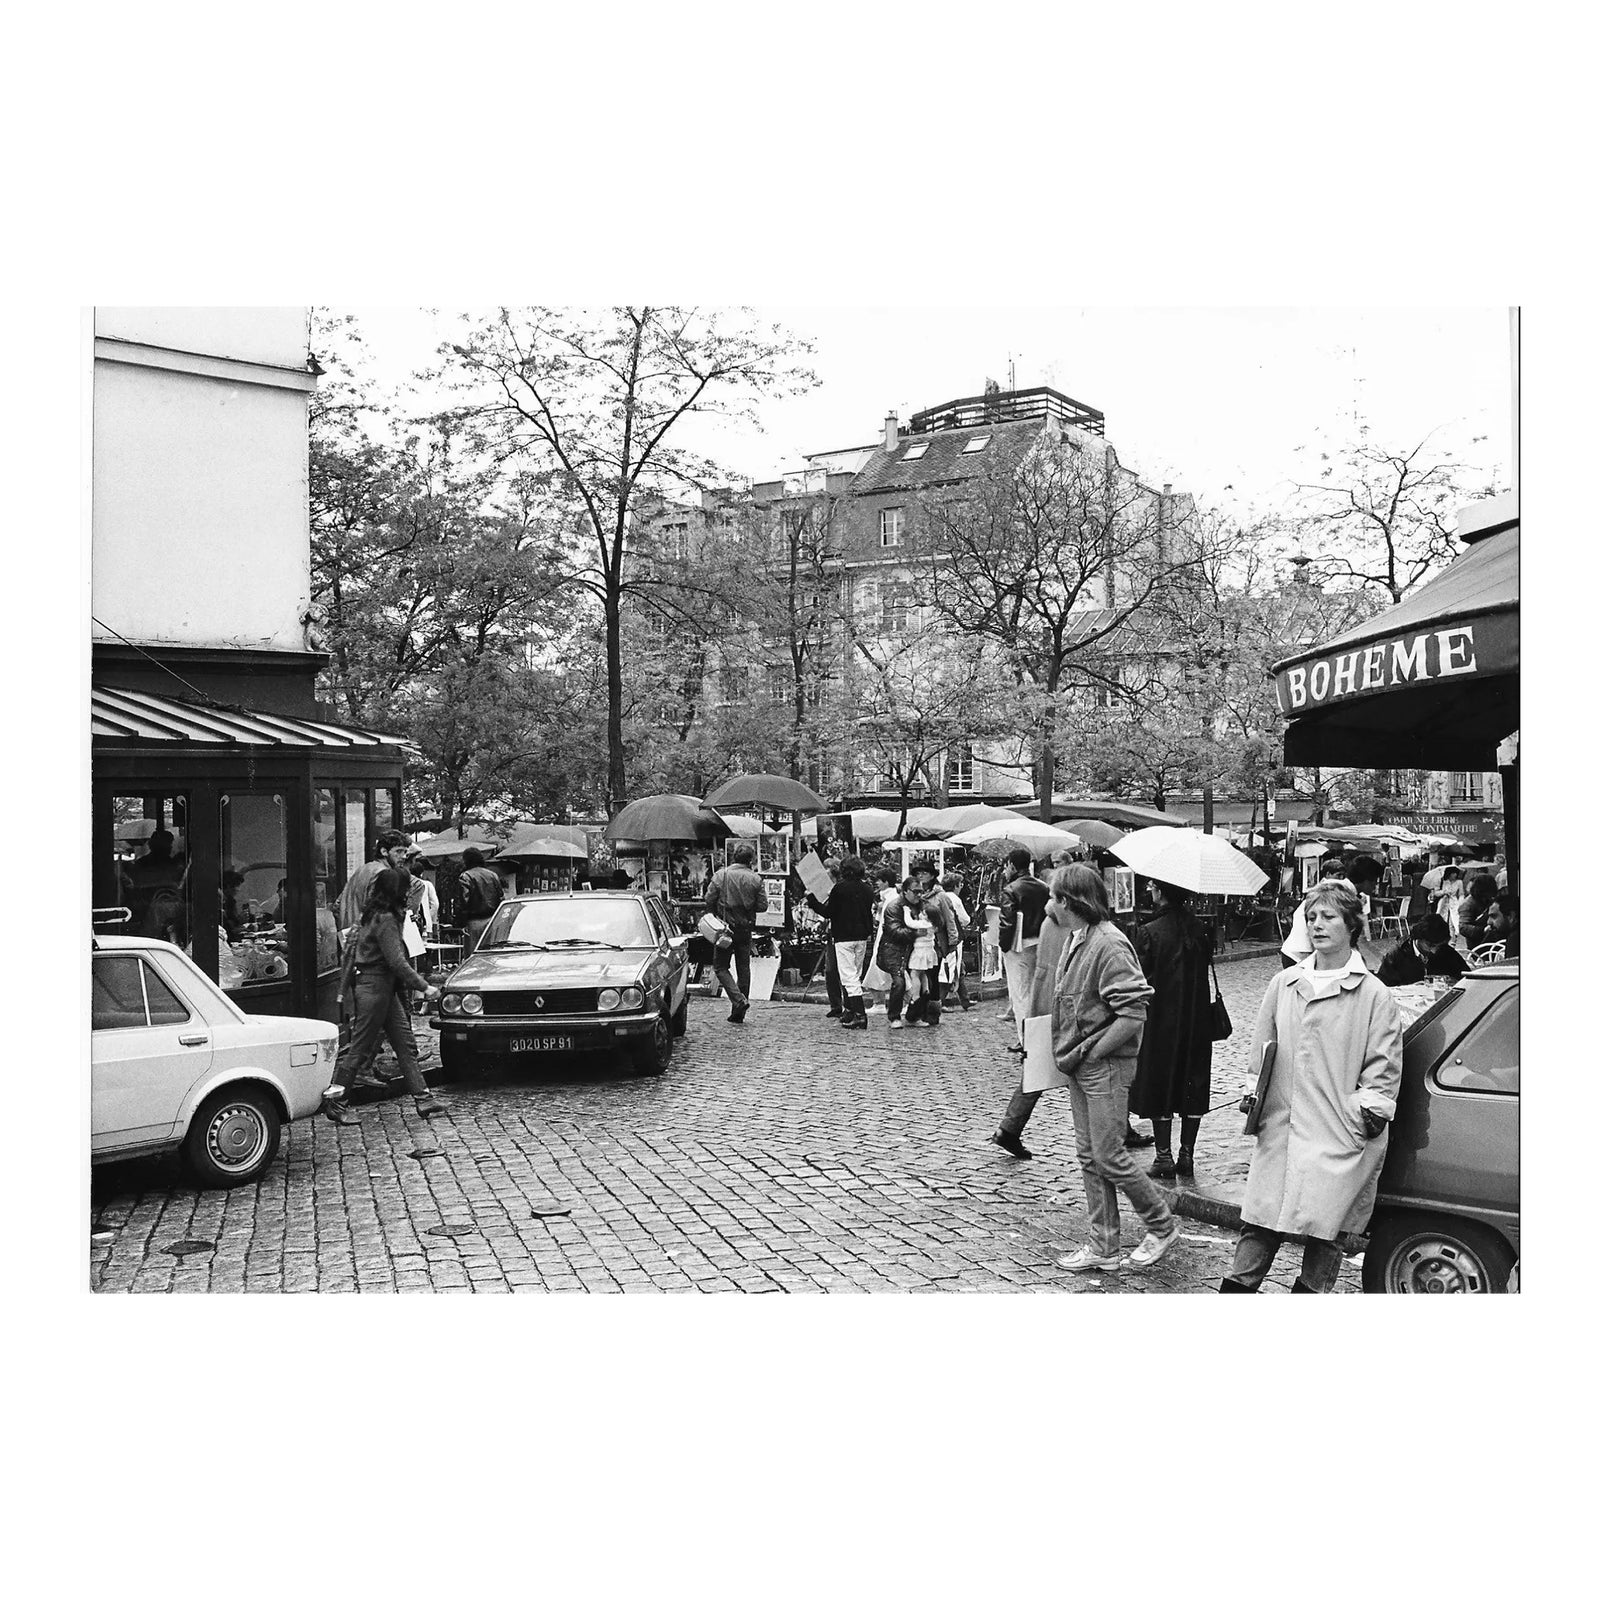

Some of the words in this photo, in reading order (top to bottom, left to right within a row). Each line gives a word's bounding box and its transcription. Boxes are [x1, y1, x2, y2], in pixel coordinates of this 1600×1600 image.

[1288, 626, 1477, 708] BOHEME
[1388, 816, 1428, 824] OMMUNE
[1431, 816, 1459, 824] LIBRE
[1413, 824, 1478, 833] MONTMARTRE
[512, 1038, 540, 1051] 3020
[543, 1037, 556, 1050] SP
[558, 1037, 571, 1049] 91
